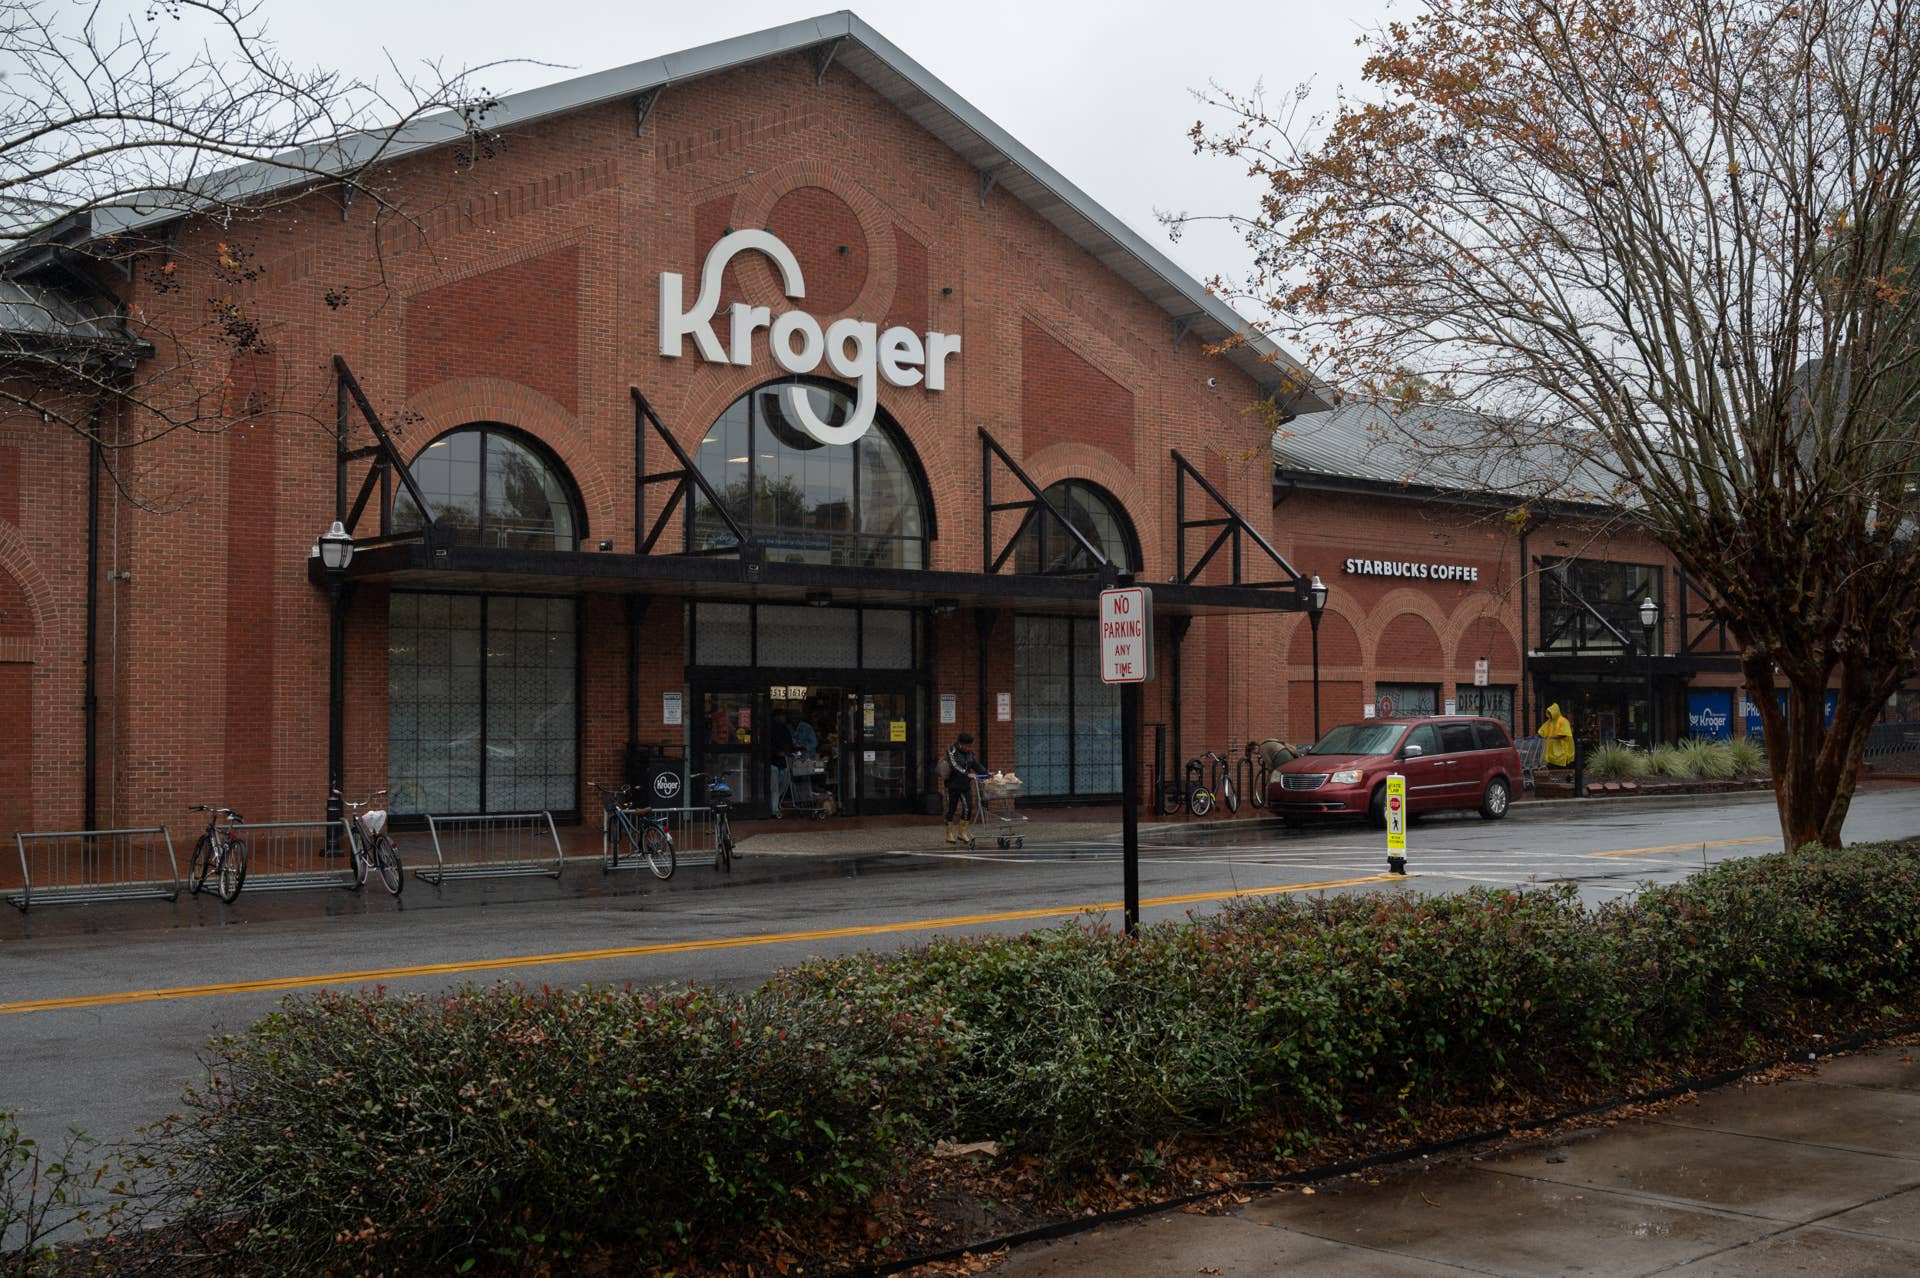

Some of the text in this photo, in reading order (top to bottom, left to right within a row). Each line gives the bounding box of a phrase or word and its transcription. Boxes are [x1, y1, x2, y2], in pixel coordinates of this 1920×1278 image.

[658, 228, 961, 445] Kroger
[1346, 558, 1478, 581] STARBUCKS COFFEE
[1113, 597, 1129, 614] NO
[1104, 620, 1141, 638] PARKING
[1115, 644, 1131, 656] ANY
[1115, 662, 1132, 674] TIME
[1458, 694, 1503, 711] DISCOVER
[1699, 708, 1727, 735] Kroger
[657, 776, 678, 795] Kroger
